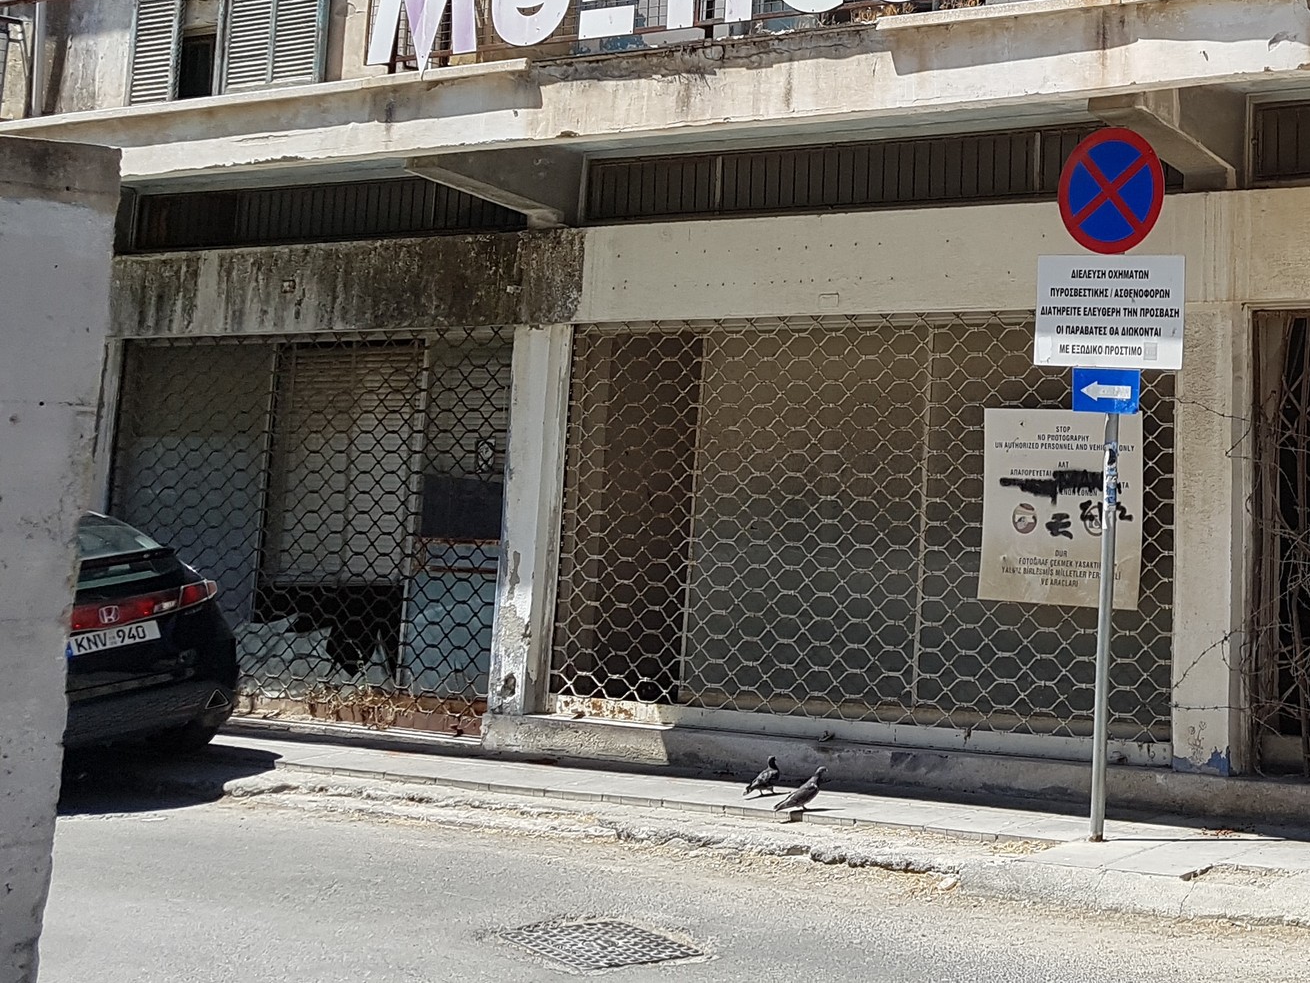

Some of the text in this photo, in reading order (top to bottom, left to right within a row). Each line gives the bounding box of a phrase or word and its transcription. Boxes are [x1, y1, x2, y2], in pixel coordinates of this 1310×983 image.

[1071, 269, 1149, 279] ΔΙΕΛΕΥΣΗ ΟΧΗΜΑΤΩΝ
[1050, 287, 1108, 297] ΠΥΡΟΣΒΕΣΤΙΚΗΣ
[1114, 288, 1170, 298] ΑΣΘΕΝΟΦΟΡΩΝ
[1040, 306, 1180, 318] ΔΙΑΤΗΡΕΙΤΕ ΕΛΕΥΘΕΡΗ ΤΗΝ ΠΡΟΣΒΑΣΗ
[1056, 325, 1161, 337] ΟΙ ΠΑΡΑΒΑΤΕΣ ΘΑ ΔΙΩΚΟΝΤΑΙ
[1059, 344, 1142, 356] ΜΕ ΕΞΩΔΙΚΟ ΠΡΟΣΤΙΜΟ
[1040, 443, 1074, 451] PERSONNEL
[74, 625, 147, 653] KNV 940
